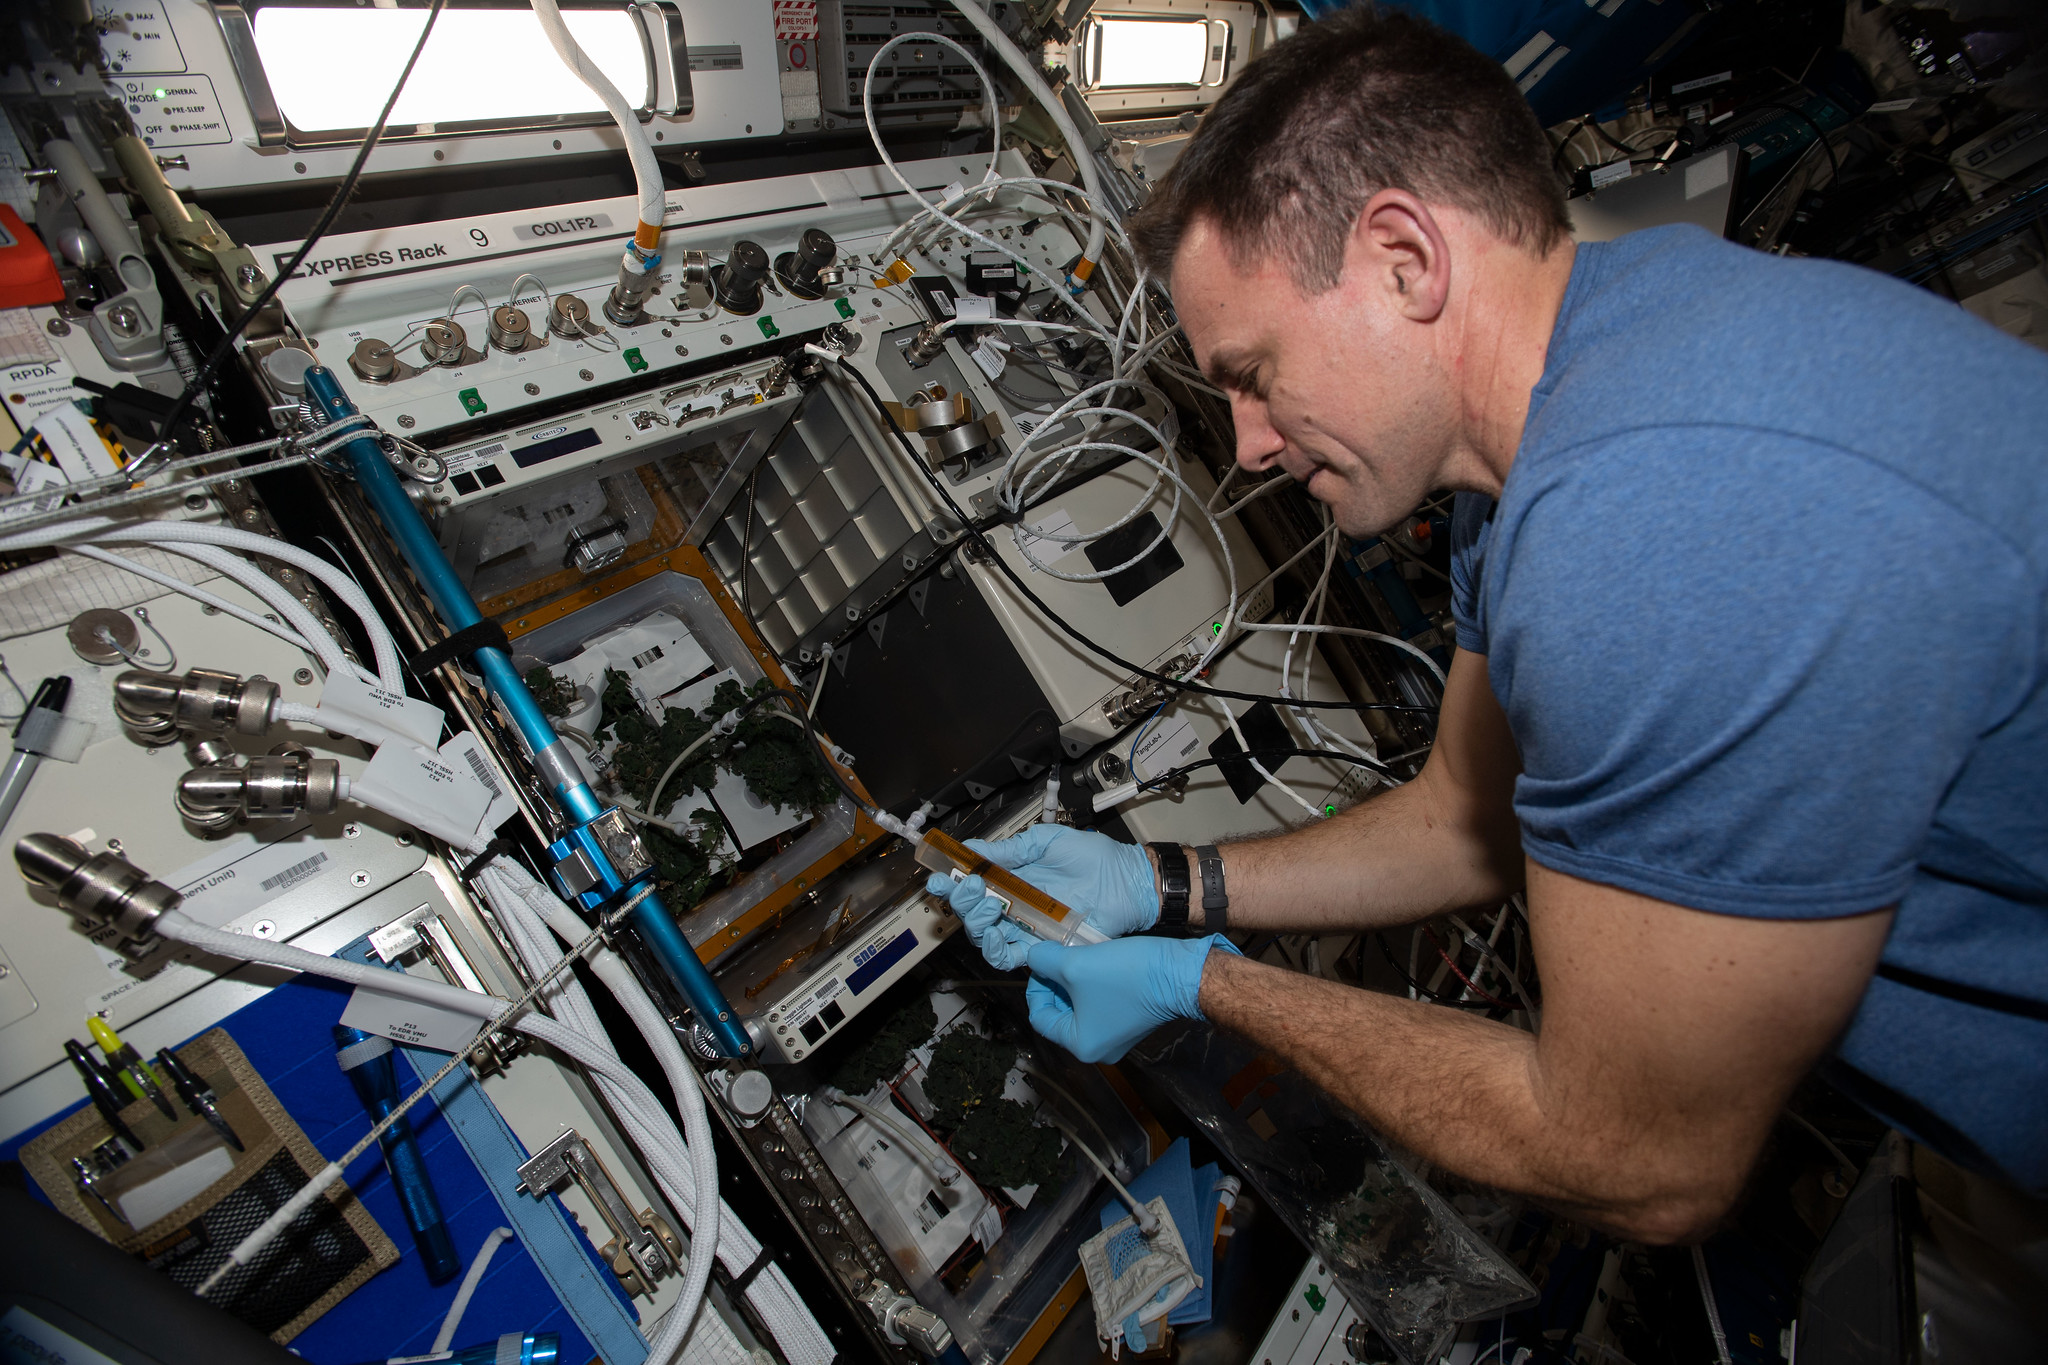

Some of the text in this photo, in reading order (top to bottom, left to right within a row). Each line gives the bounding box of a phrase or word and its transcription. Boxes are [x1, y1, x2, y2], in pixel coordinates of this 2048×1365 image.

[128, 94, 158, 104] MODE
[146, 125, 163, 134] OFF
[179, 122, 220, 132] PHASE-SHIFT
[531, 217, 598, 238] COL1F2
[468, 228, 490, 248] 9
[273, 242, 448, 280] EXPRESS Rack
[10, 366, 57, 382] RPDA
[450, 468, 466, 476] ENTER
[368, 692, 382, 701] VMU
[388, 692, 402, 701] HSSL
[384, 698, 396, 706] EDR
[1136, 732, 1162, 757] TangoLab-4
[420, 763, 433, 772] VMU
[439, 766, 454, 776] HSSL
[428, 774, 440, 782] P12
[434, 770, 446, 779] EDR
[208, 869, 236, 888] Unit)
[282, 866, 322, 889] EDR00004E
[108, 958, 123, 969] P/N
[101, 982, 132, 1002] SPACE
[819, 1000, 829, 1008] NEXT
[783, 997, 812, 1022] Veggie Lightcap
[798, 1014, 811, 1026] ENTER
[390, 1032, 406, 1040] HSSL
[398, 1026, 412, 1035] EDR
[412, 1030, 428, 1038] VMU
